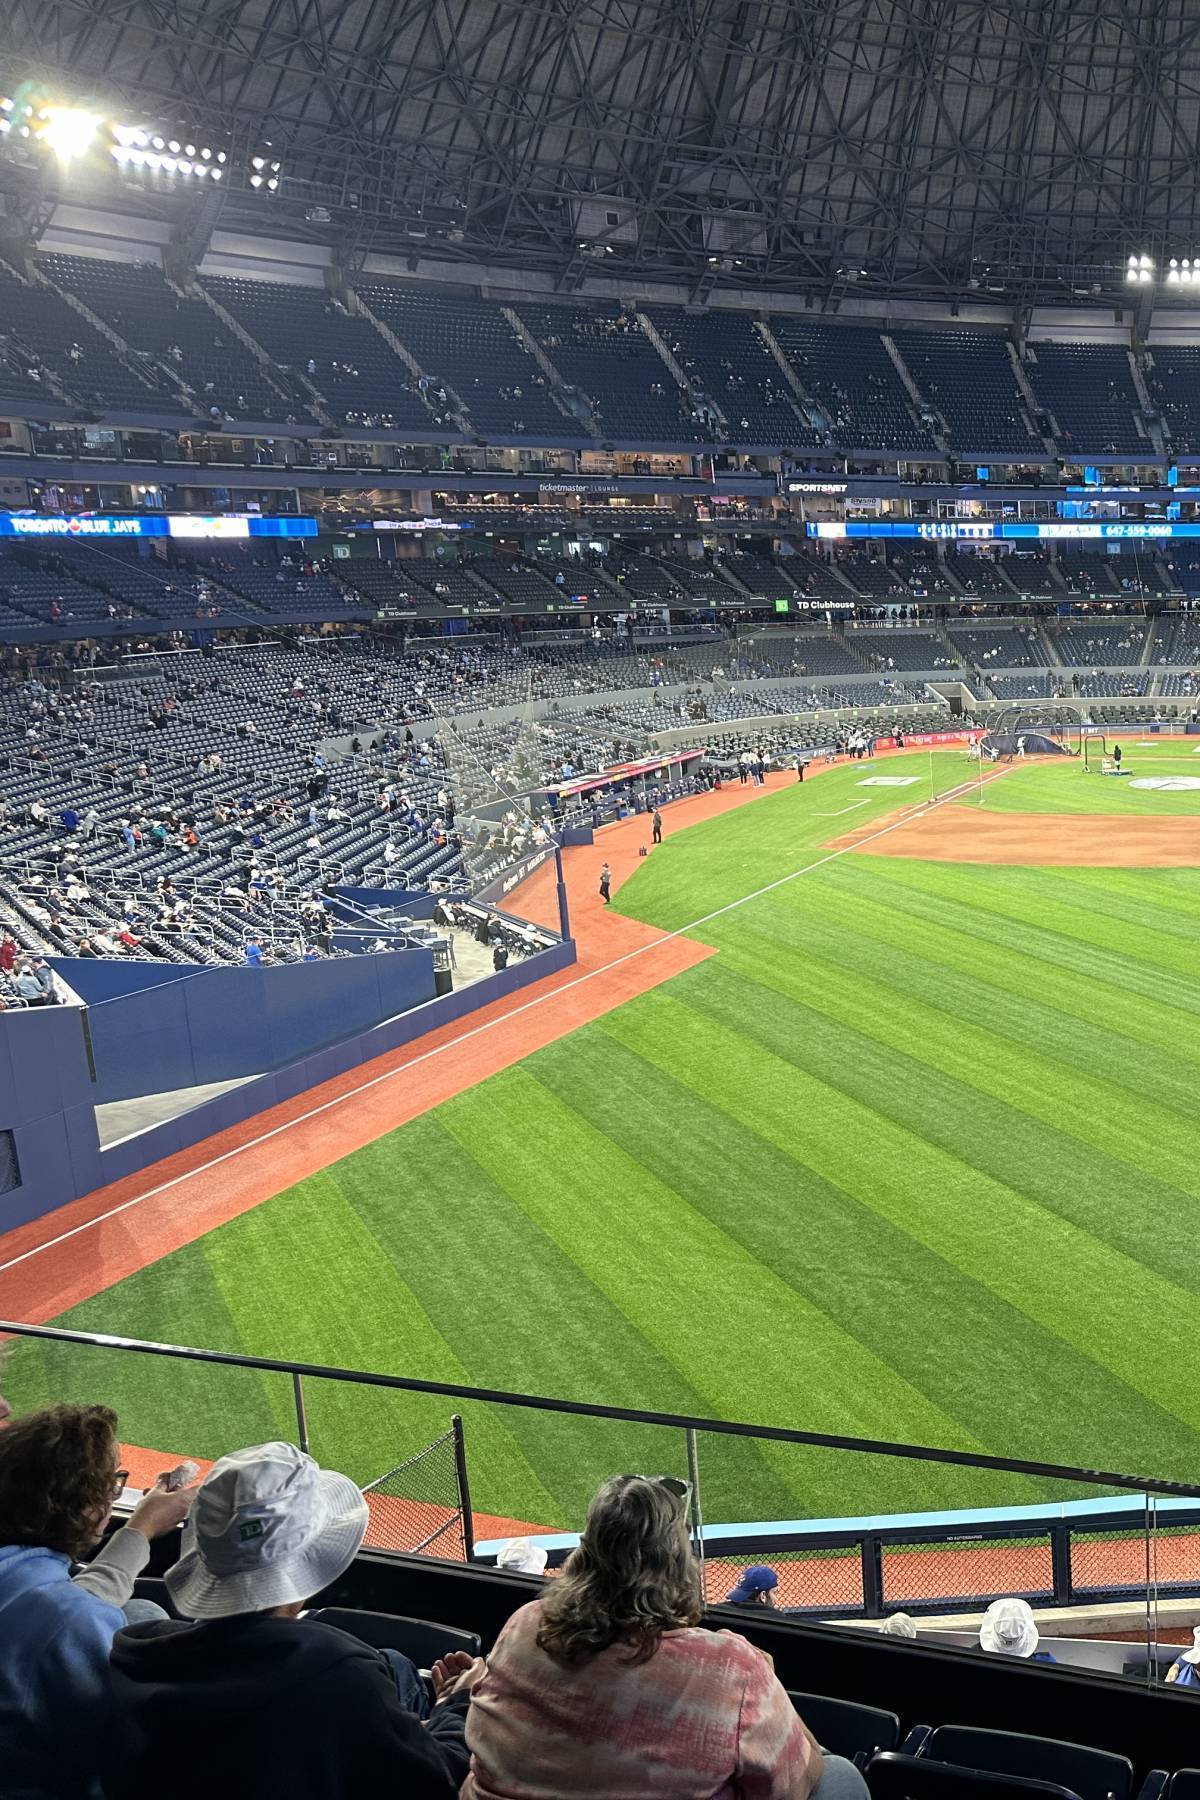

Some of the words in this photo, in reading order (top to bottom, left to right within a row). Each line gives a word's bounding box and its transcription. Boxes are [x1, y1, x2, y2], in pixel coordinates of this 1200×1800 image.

[539, 483, 586, 492] ticketmaster
[788, 483, 848, 492] SPORTSNET
[10, 518, 68, 533] TORONTO
[81, 518, 109, 533] BLUE
[112, 519, 141, 533] JAYS
[797, 601, 810, 609] TD
[811, 601, 855, 609] Clubhouse
